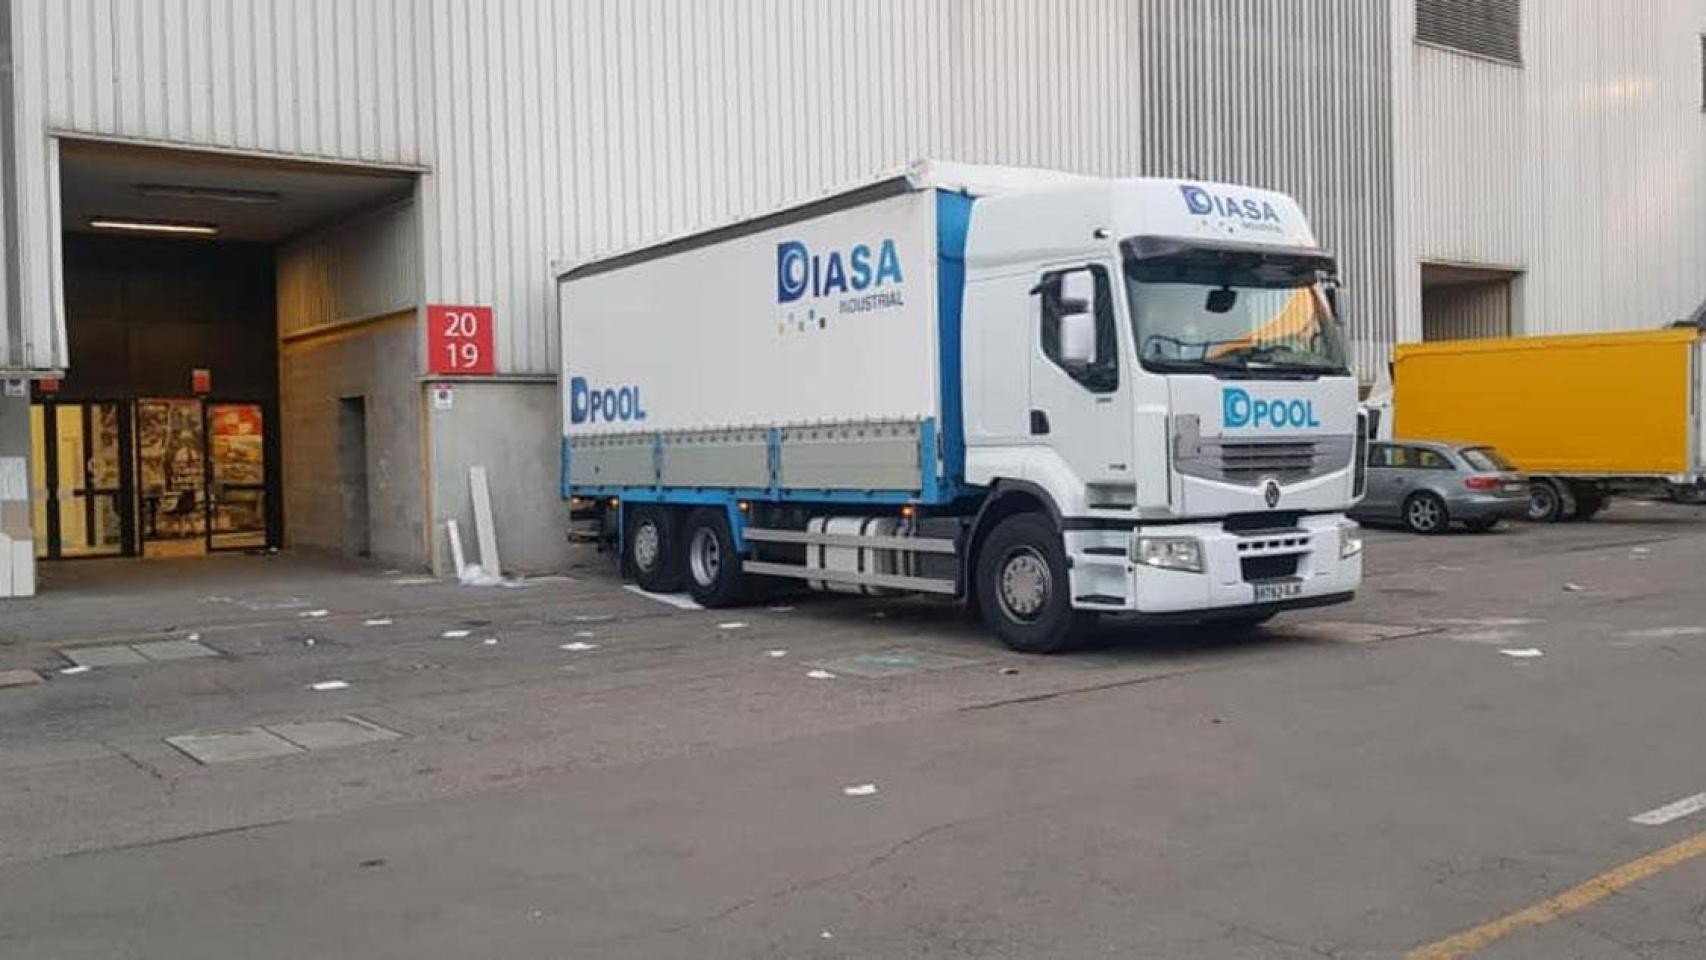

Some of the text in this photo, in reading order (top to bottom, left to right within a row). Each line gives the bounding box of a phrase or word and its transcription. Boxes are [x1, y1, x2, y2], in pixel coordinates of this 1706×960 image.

[444, 311, 477, 337] 20
[447, 343, 478, 368] 19
[571, 376, 646, 424] DPOOL
[1222, 388, 1320, 428] DPOOL
